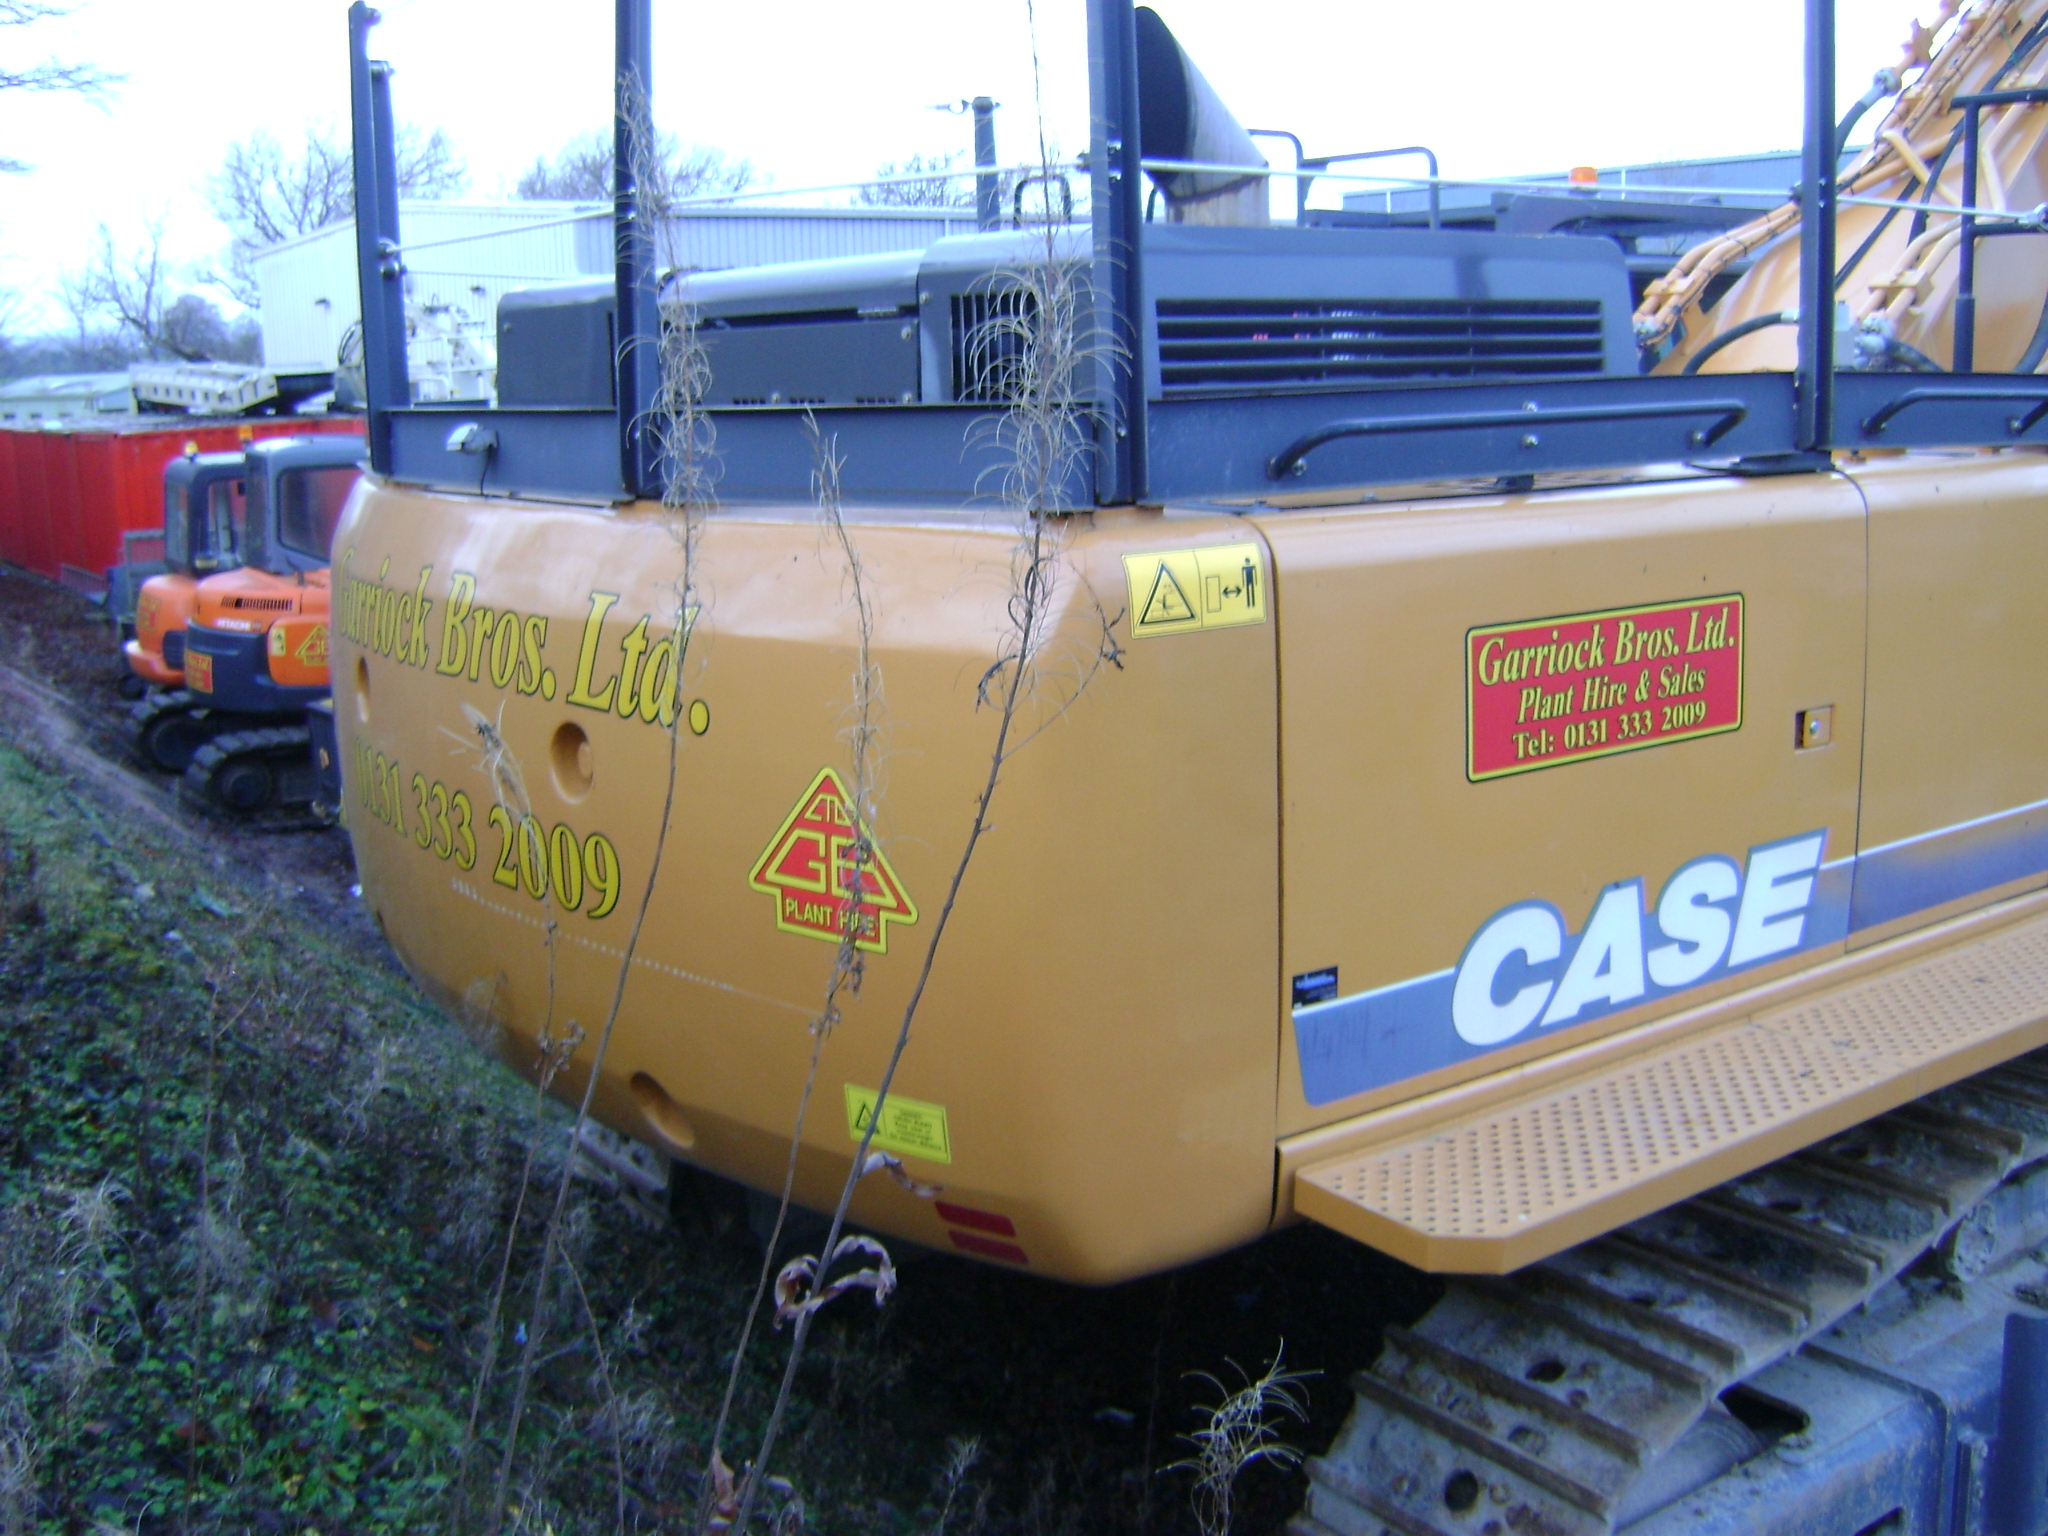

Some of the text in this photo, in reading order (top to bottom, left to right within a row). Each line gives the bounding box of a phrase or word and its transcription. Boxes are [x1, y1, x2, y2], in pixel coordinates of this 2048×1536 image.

[436, 569, 556, 700] Bros.
[566, 590, 710, 736] Ltd.
[1477, 606, 1736, 687] Garriock Bros. Ltd.
[1512, 700, 1707, 760] Tel: 0131 333 2009
[1516, 662, 1706, 725] Plant Hire & Sales
[355, 736, 621, 919] 0131 333 2009
[785, 897, 877, 938] PLANT HIE
[1452, 831, 1826, 1048] CASE
